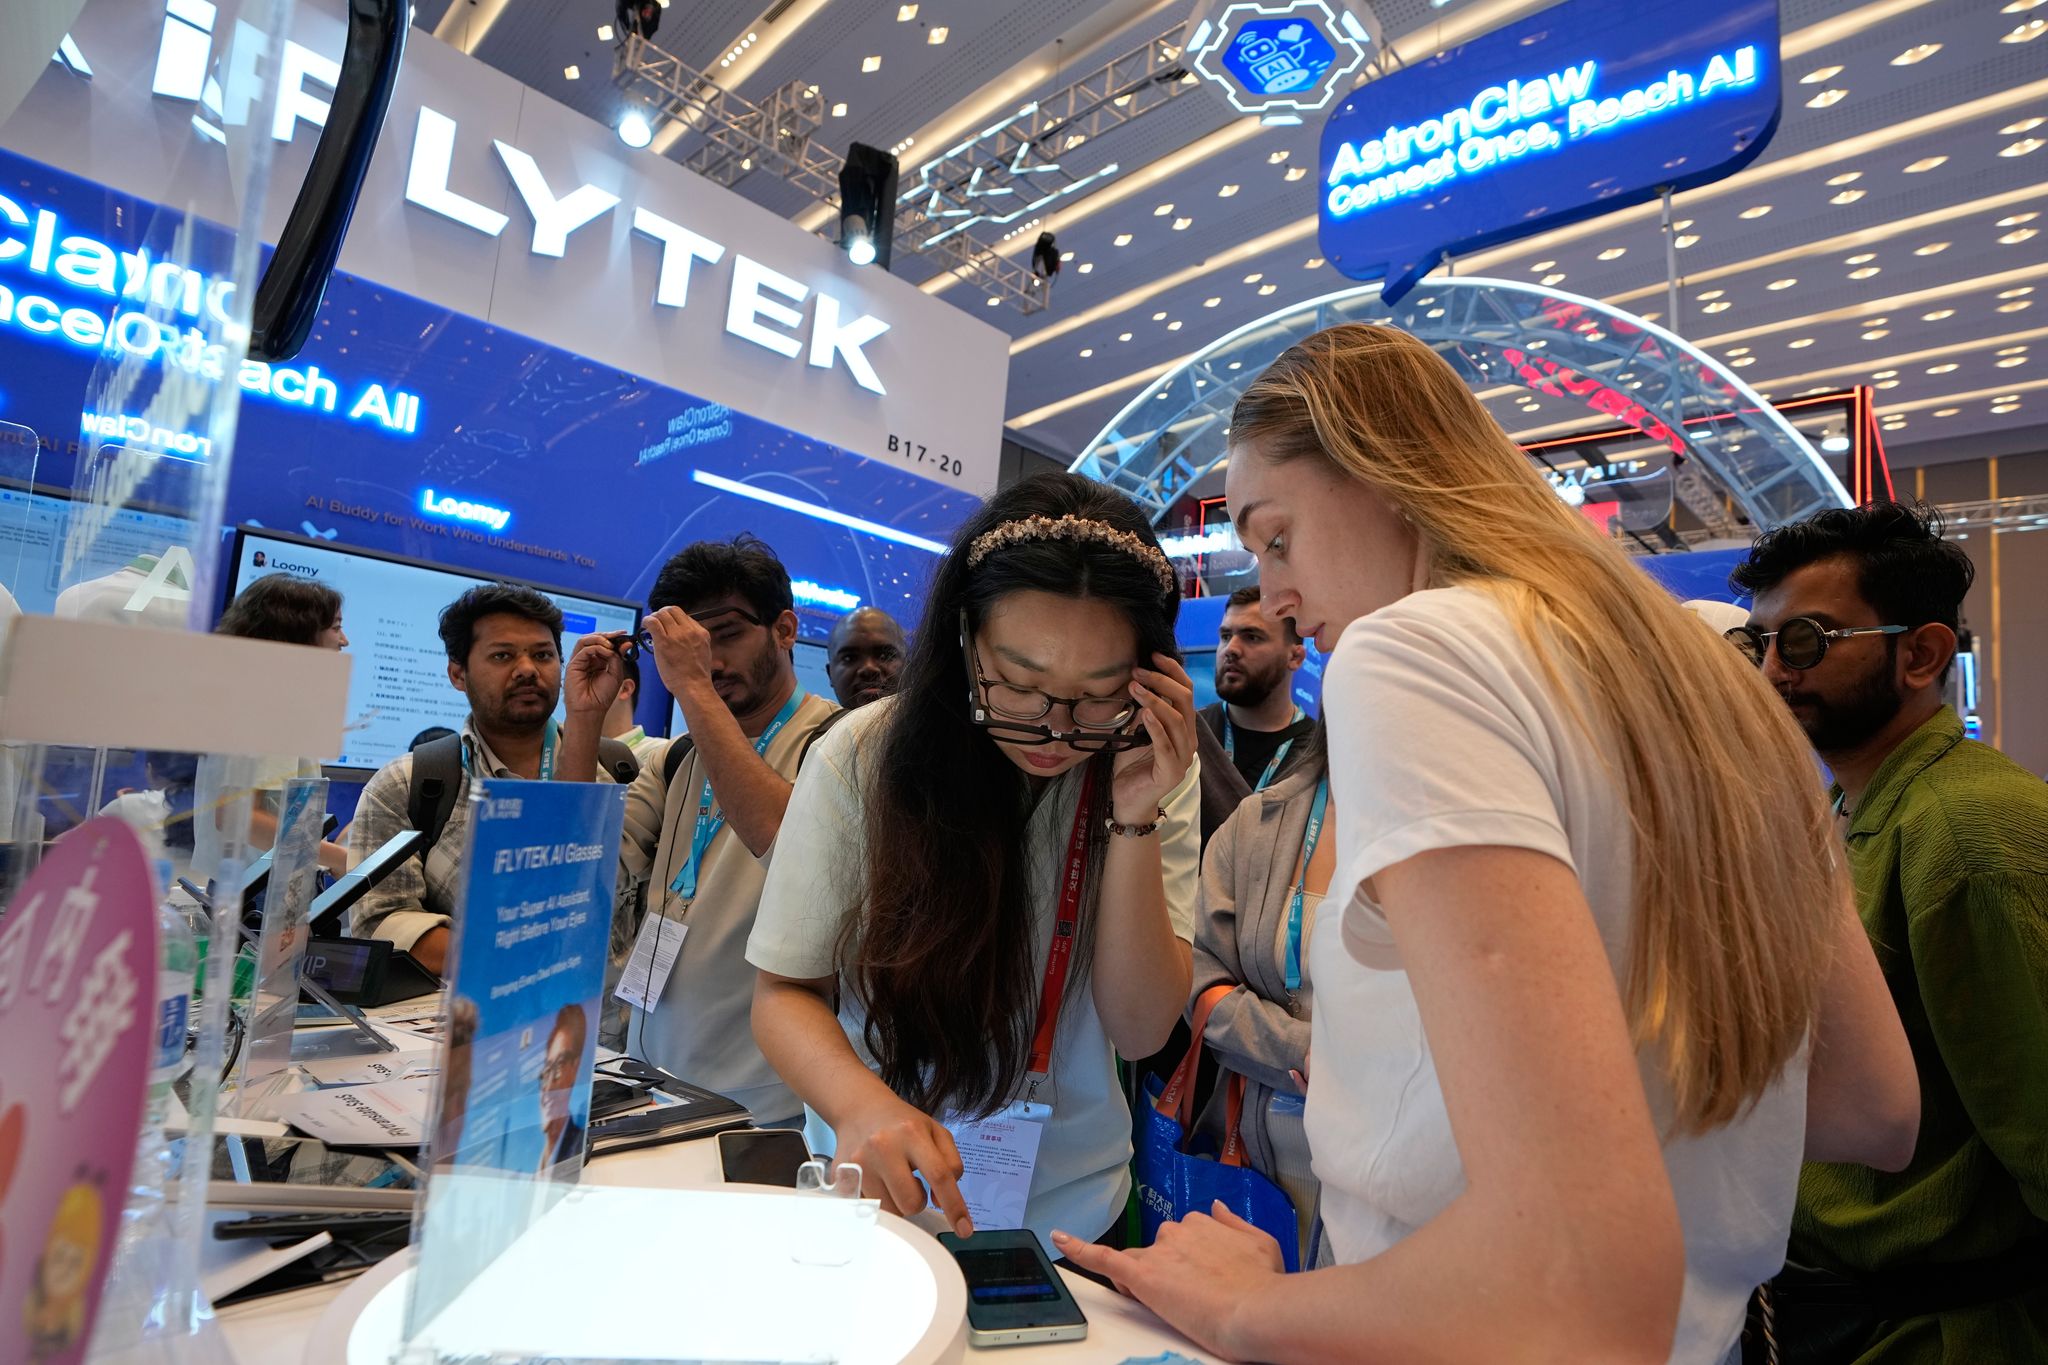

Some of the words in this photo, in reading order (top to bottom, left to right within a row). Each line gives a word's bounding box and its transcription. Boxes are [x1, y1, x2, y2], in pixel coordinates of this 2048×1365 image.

[1267, 59, 1285, 76] AI
[1328, 61, 1598, 185] AstronClaw
[1328, 159, 1457, 217] Connect
[1457, 122, 1560, 172] Once,
[1567, 69, 1693, 136] Reach
[1699, 45, 1757, 94] All
[350, 382, 421, 434] All
[888, 434, 962, 477] B17-20
[424, 489, 511, 530] Loomy
[305, 495, 323, 509] AI
[329, 500, 379, 523] Buddy
[383, 511, 404, 527] for
[410, 516, 448, 538] Work
[452, 526, 484, 543] Who
[487, 534, 568, 563] Understands
[572, 551, 597, 569] You
[271, 558, 319, 578] Loomy
[493, 845, 551, 874] iFLYTEK
[550, 844, 565, 866] AI
[565, 842, 604, 864] Glasses
[1145, 1198, 1174, 1223] iFLYTE
[1147, 1187, 1174, 1215] 科大讯
